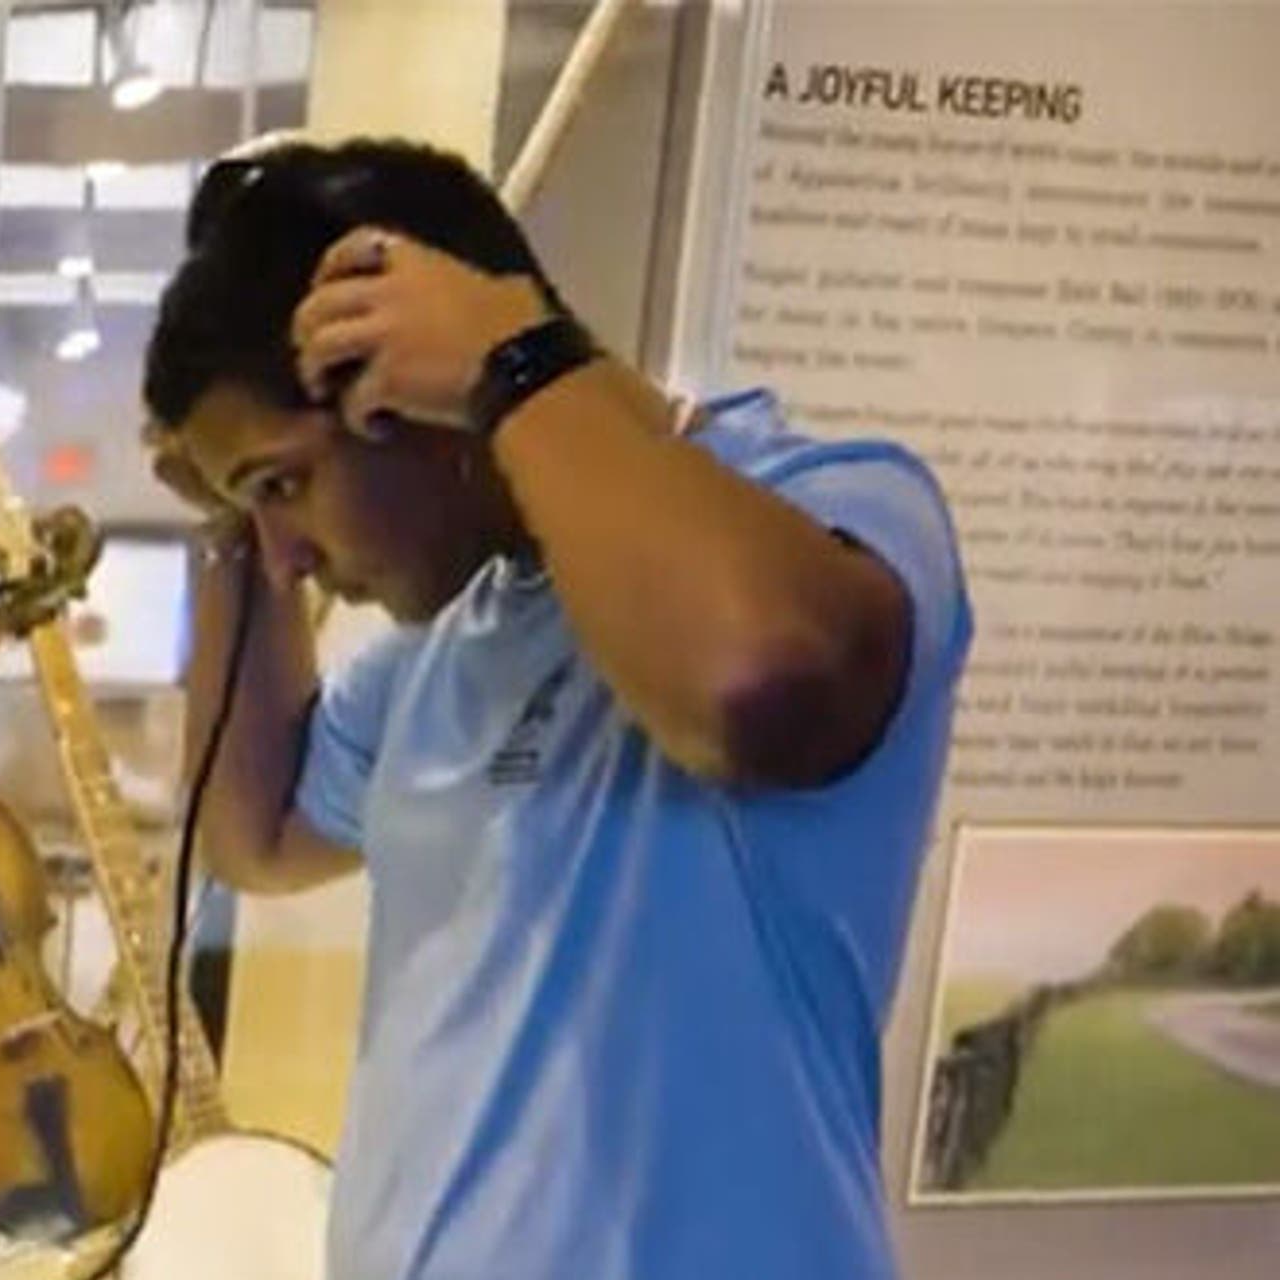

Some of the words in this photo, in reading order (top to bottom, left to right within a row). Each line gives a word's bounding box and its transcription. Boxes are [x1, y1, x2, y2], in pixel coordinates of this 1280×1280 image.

[764, 61, 789, 99] A
[798, 66, 928, 113] JOYFUL
[937, 75, 1083, 123] KEEPING
